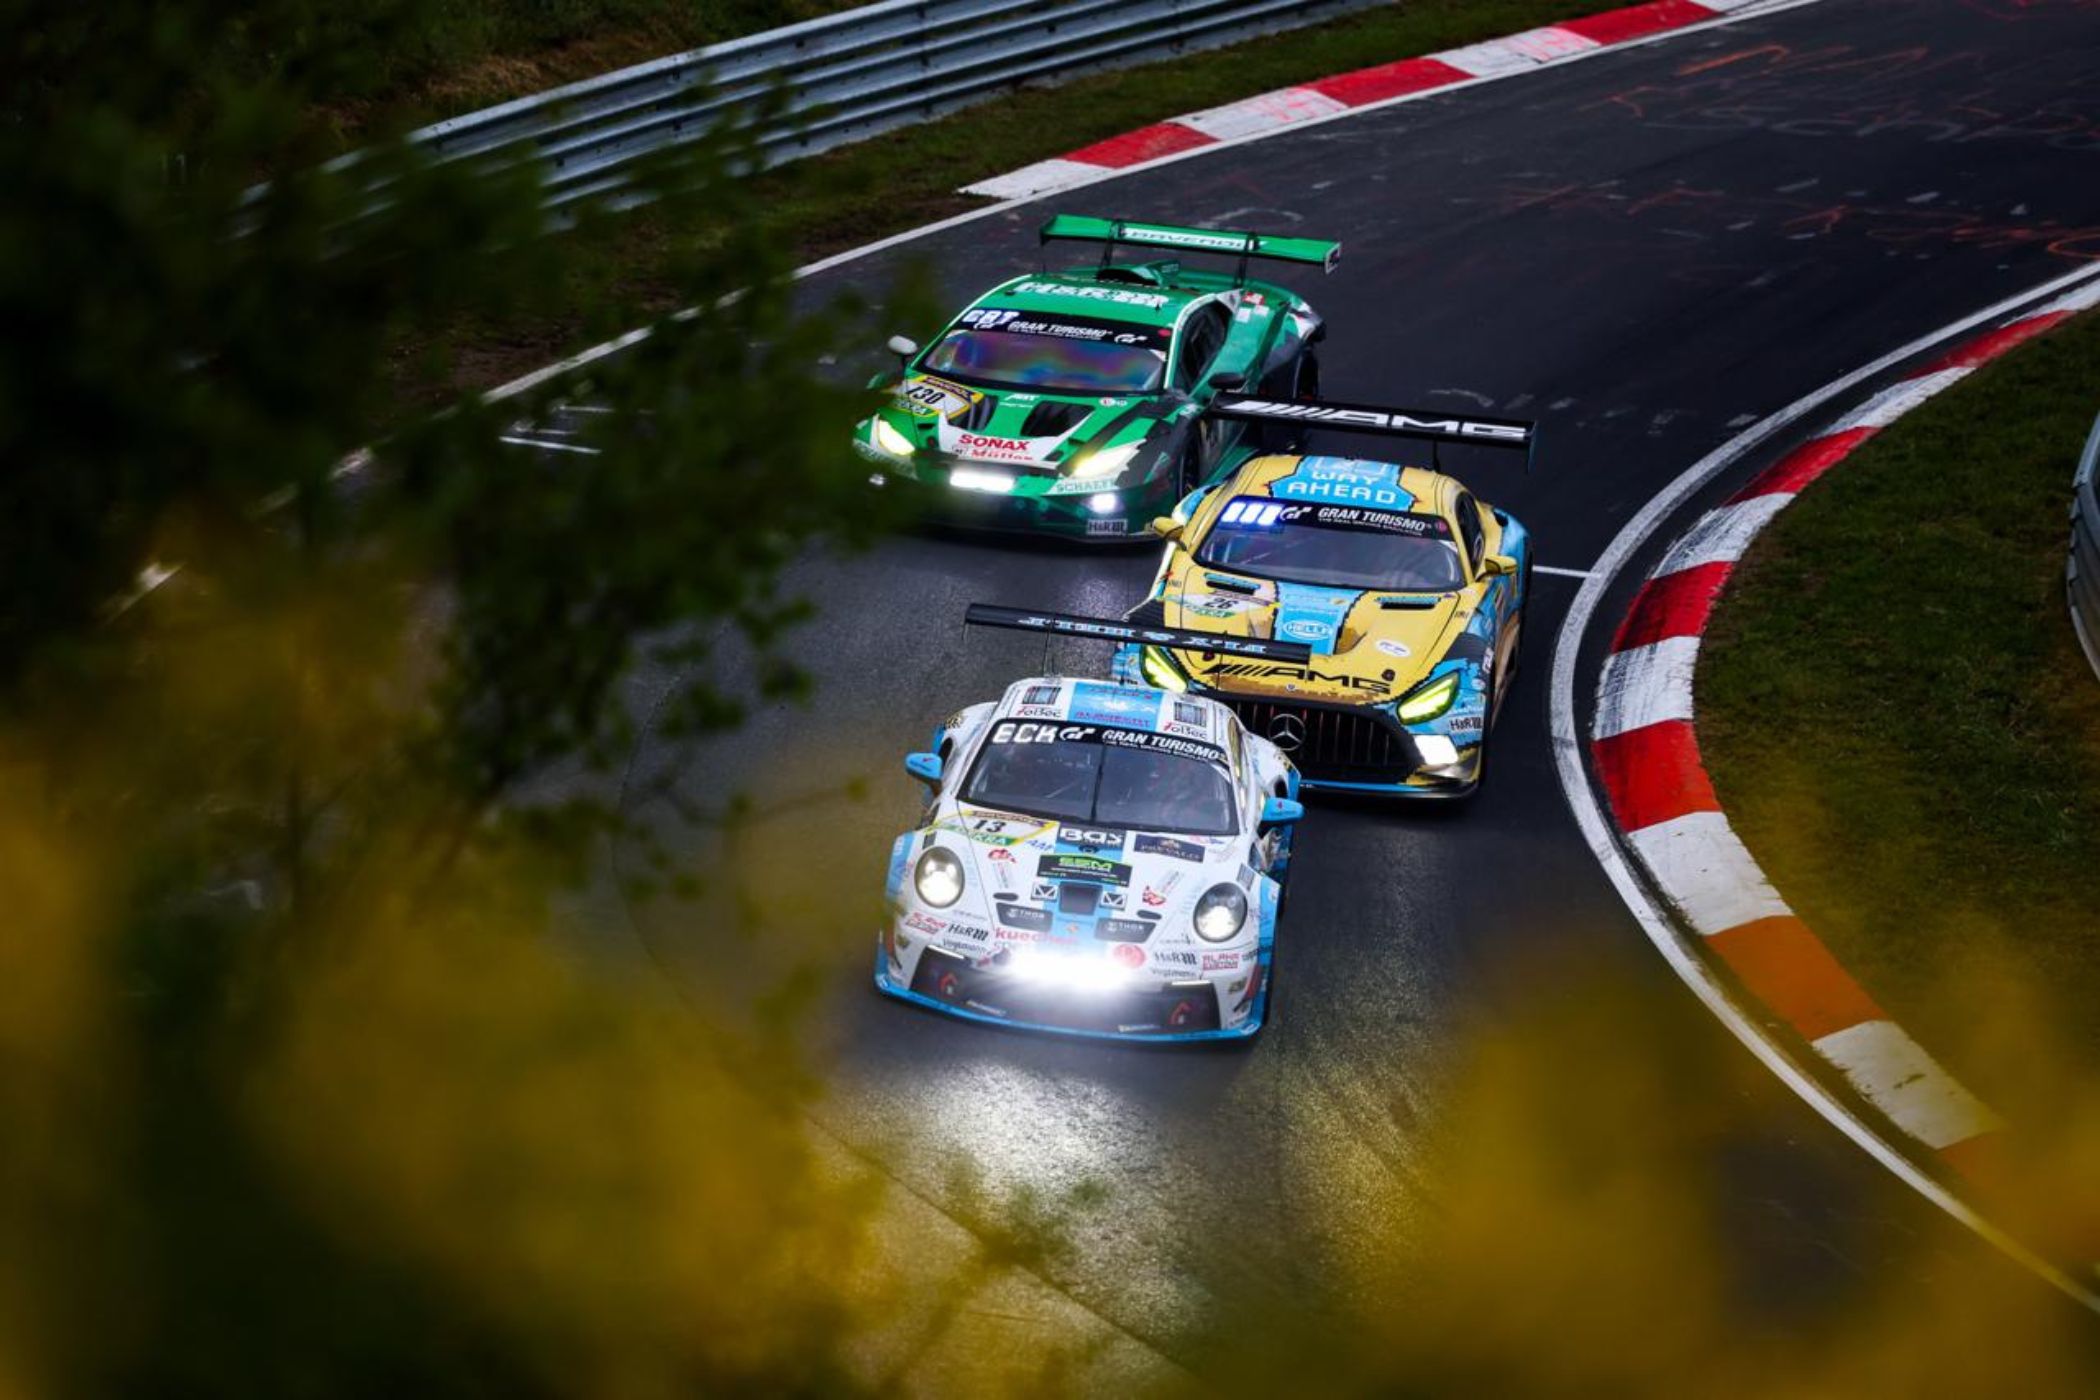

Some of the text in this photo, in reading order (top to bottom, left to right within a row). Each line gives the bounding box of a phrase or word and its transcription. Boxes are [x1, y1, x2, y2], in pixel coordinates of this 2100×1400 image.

[1009, 321, 1045, 335] GRAN
[1049, 324, 1107, 338] TURISMO
[906, 386, 946, 404] 130
[959, 434, 1031, 450] SONAX
[1312, 472, 1380, 485] WAY
[1287, 481, 1396, 504] AHEAD
[1317, 506, 1359, 520] GRAN
[1362, 510, 1426, 532] TURISMO
[1204, 598, 1239, 609] 26
[992, 723, 1057, 743] ECK
[1101, 729, 1147, 744] GRAN
[1150, 735, 1218, 761] TURISMO
[974, 820, 1006, 832] 13
[948, 924, 974, 937] H&R
